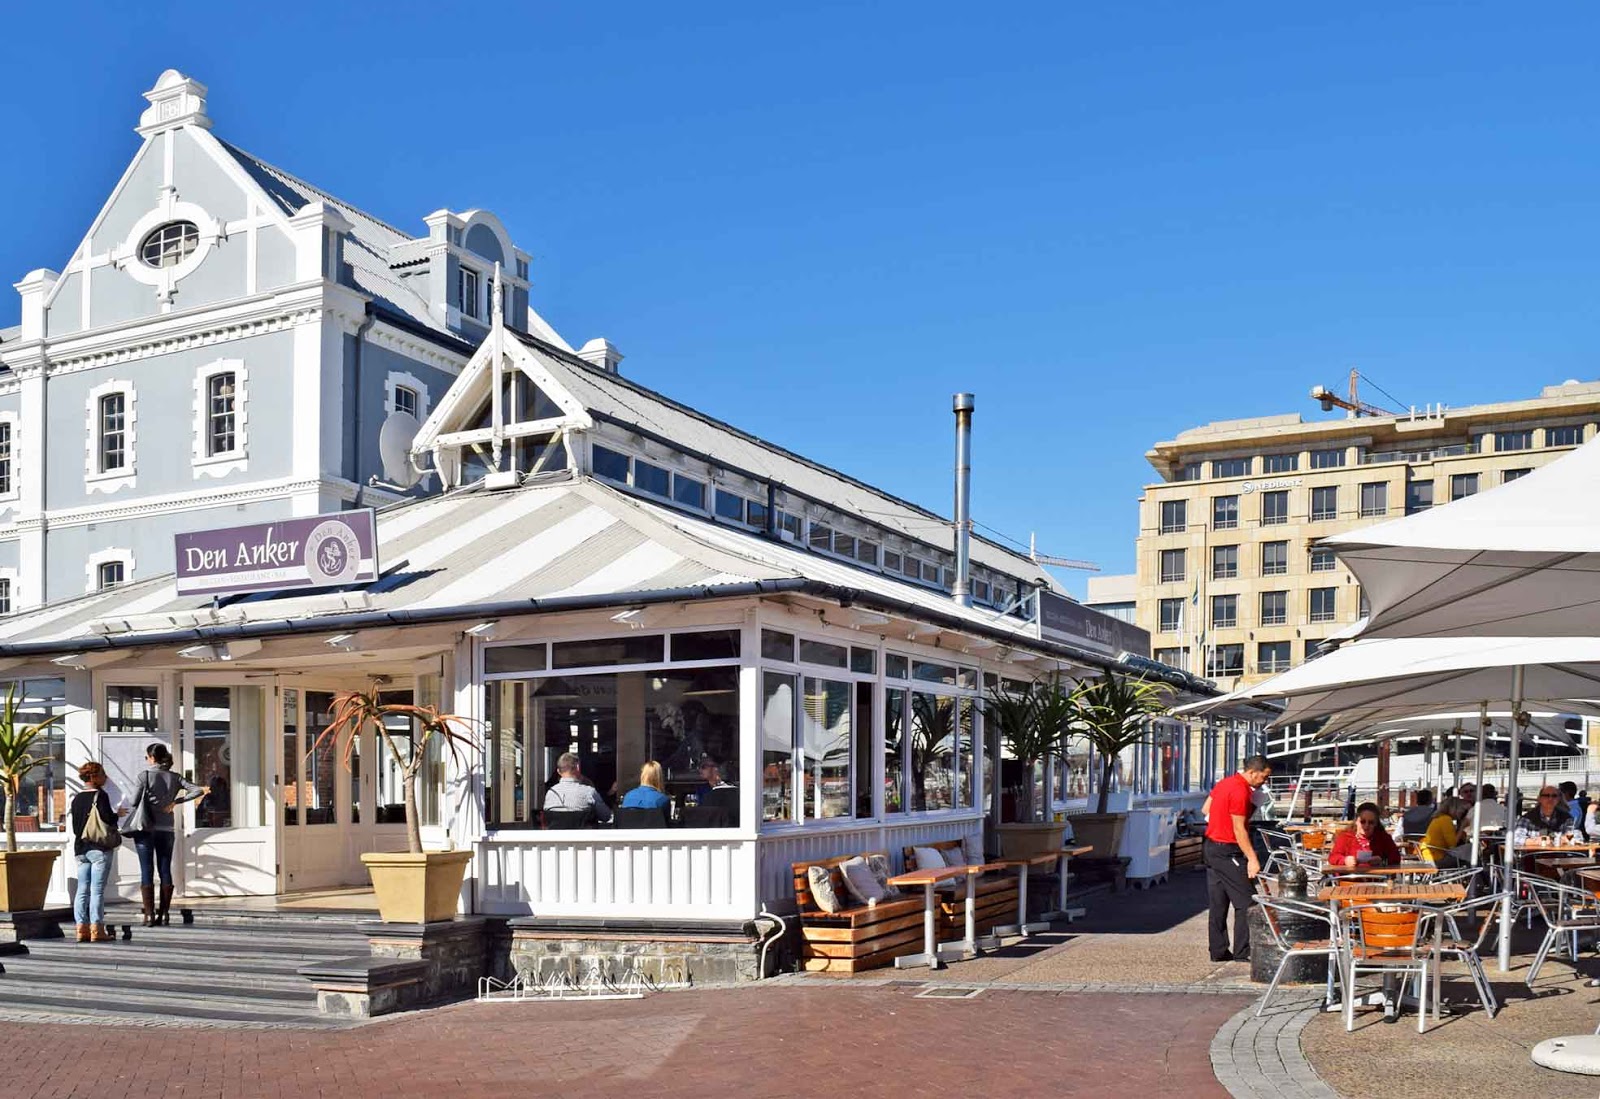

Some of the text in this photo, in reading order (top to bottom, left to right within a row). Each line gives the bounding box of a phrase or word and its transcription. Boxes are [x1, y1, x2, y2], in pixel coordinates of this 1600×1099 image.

[314, 526, 332, 542] Den
[185, 527, 299, 572] Den Anker
[1085, 619, 1097, 638] Den
